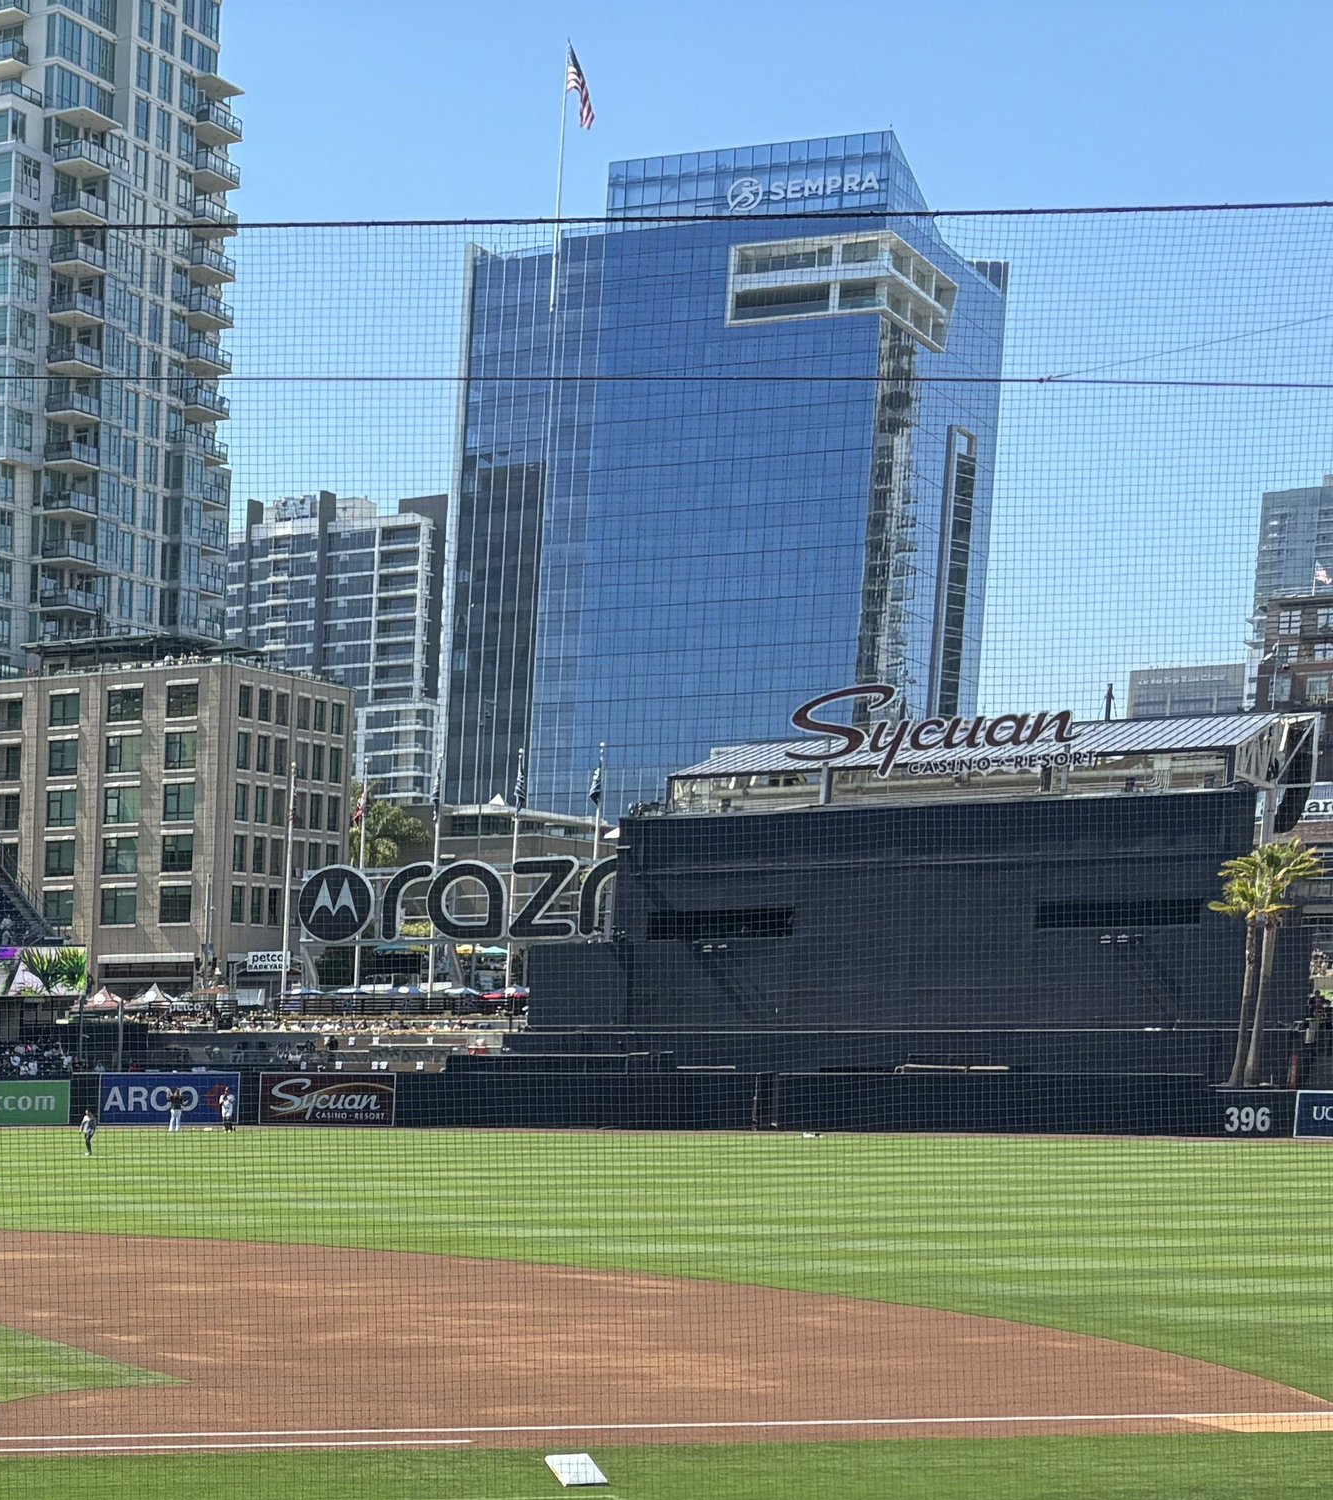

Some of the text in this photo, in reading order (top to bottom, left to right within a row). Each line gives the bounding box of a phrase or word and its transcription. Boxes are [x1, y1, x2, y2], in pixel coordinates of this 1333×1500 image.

[769, 171, 880, 201] SEMPRA
[785, 683, 1083, 779] Sycuan
[908, 751, 1098, 776] CASINO RESORT
[382, 853, 618, 942] razr
[103, 1086, 199, 1112] ARCO
[270, 1078, 380, 1121] Sycuan
[315, 1111, 386, 1120] CASINO RESORT
[1224, 1106, 1271, 1132] 396
